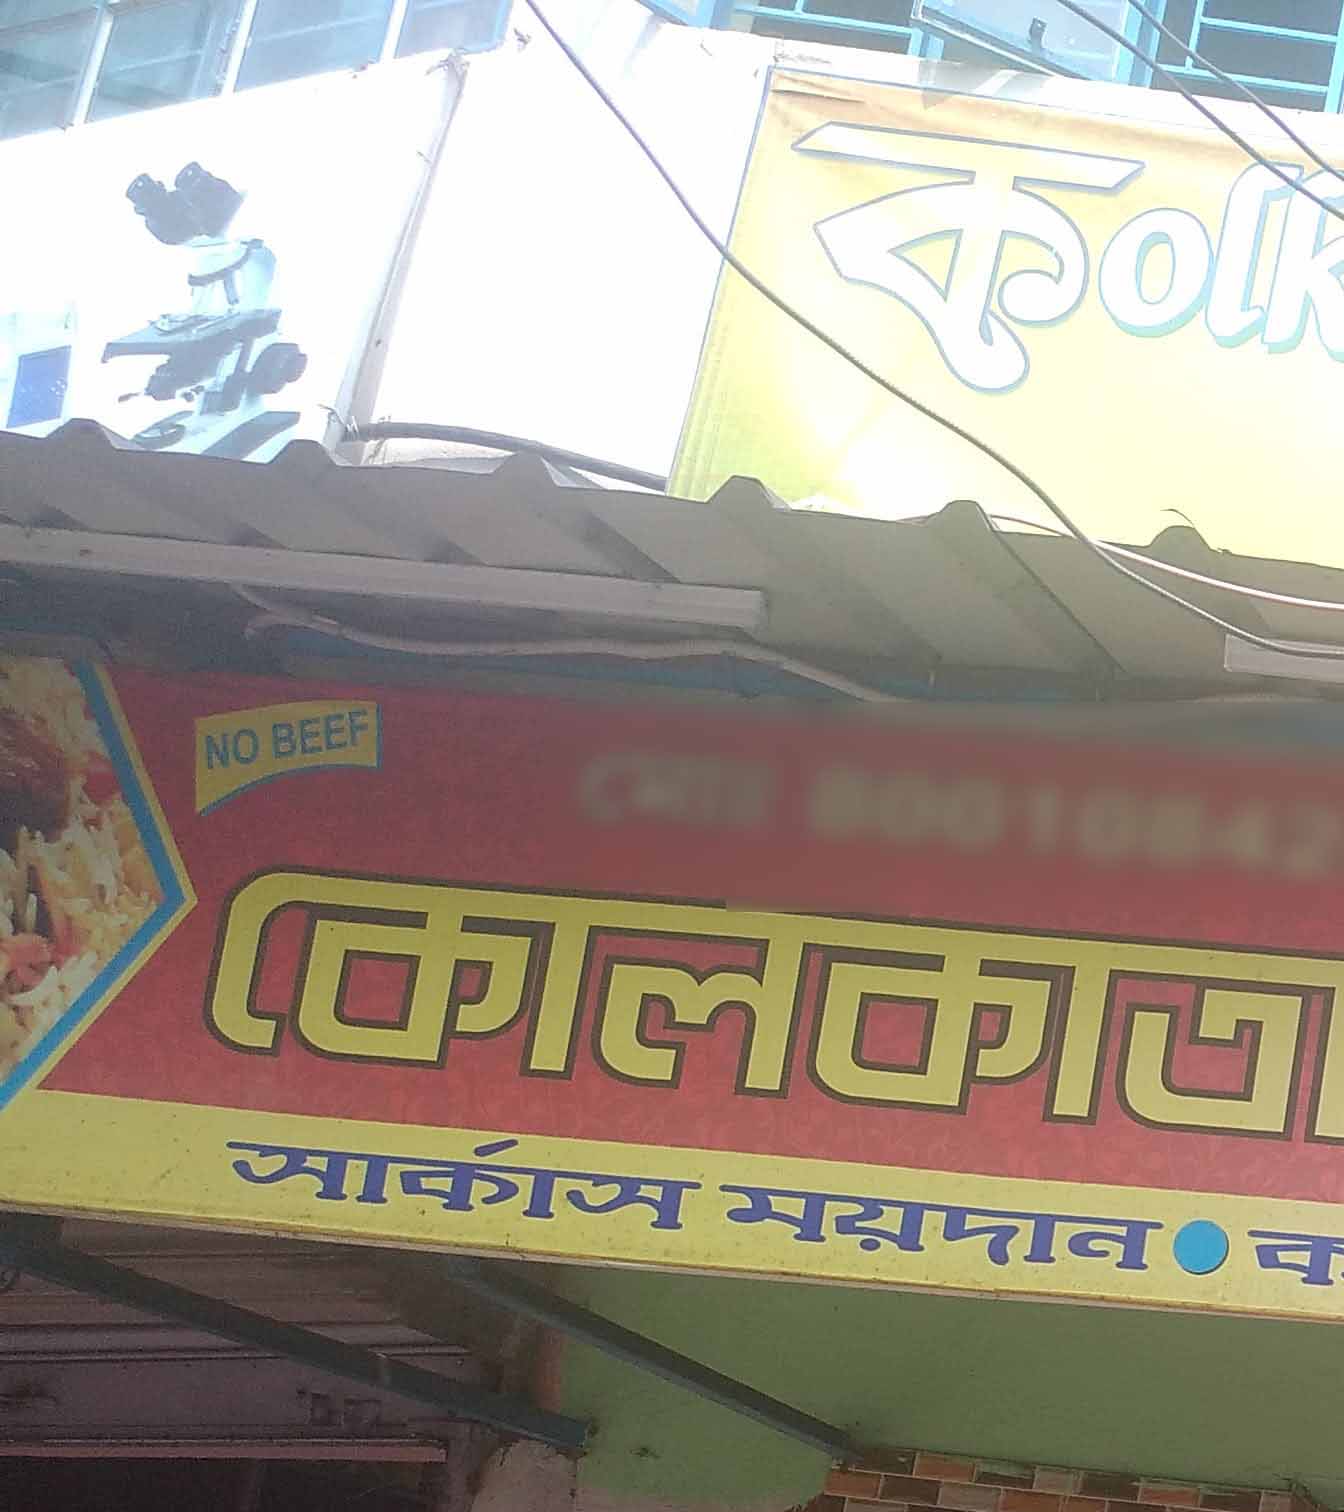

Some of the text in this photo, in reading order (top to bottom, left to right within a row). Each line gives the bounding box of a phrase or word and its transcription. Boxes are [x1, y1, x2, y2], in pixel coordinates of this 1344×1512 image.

[203, 709, 371, 770] NO BEEF
[226, 1137, 700, 1231] সার্কাস
[719, 1181, 1163, 1271] ময়দান
